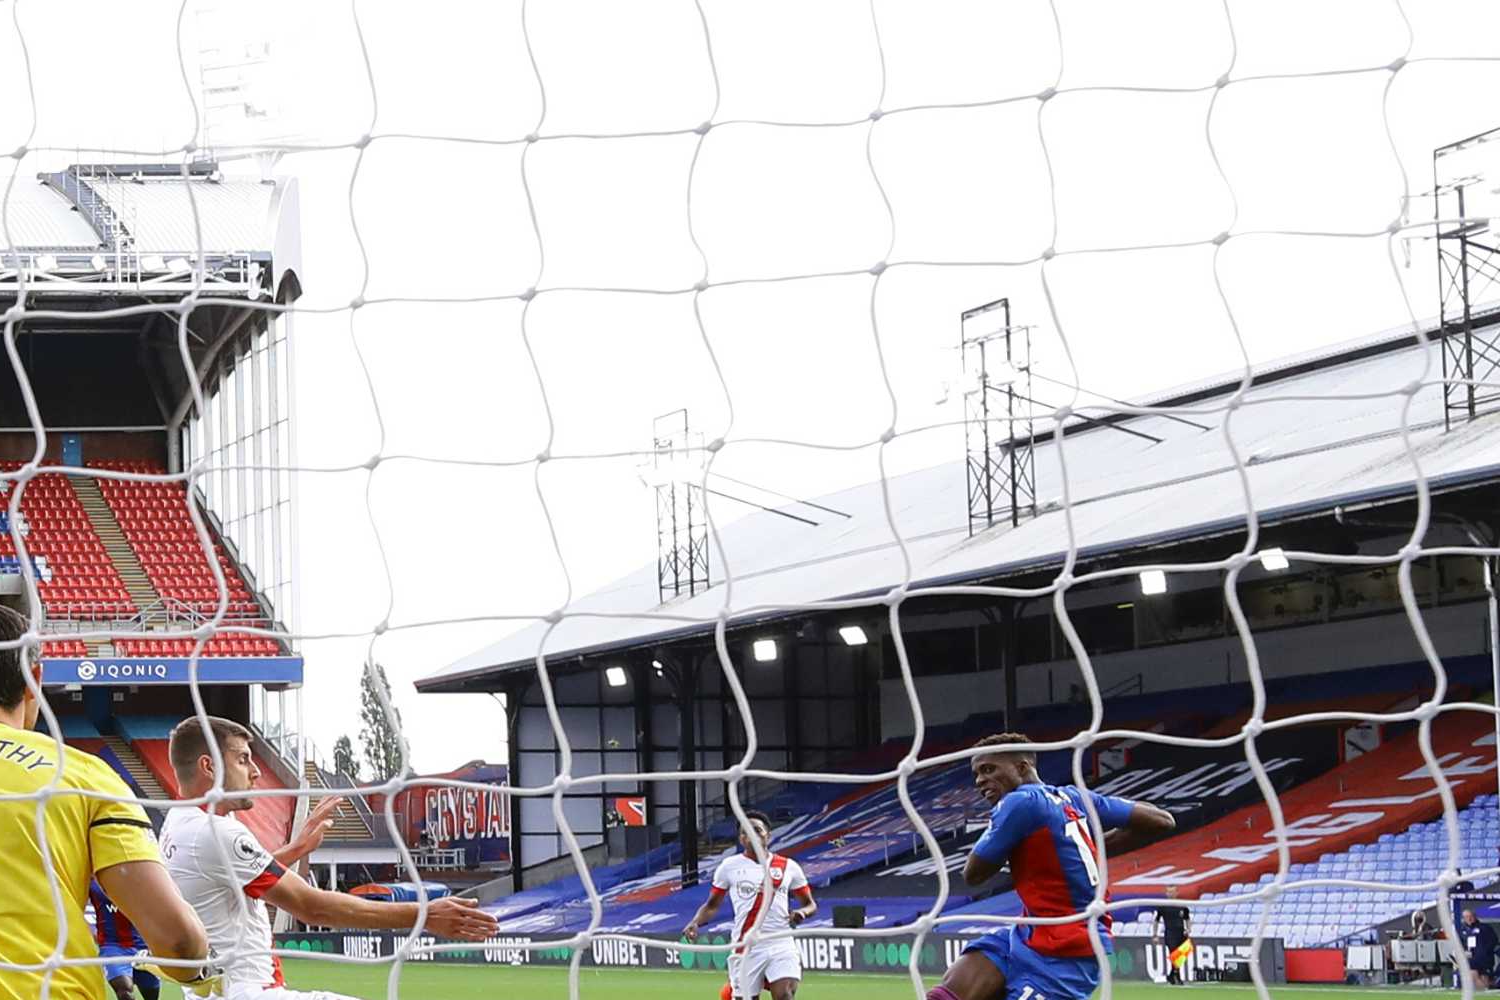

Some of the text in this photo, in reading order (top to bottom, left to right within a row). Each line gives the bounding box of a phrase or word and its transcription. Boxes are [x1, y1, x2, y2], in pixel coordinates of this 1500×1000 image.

[99, 663, 167, 678] IQONIQ
[425, 781, 510, 843] CRYSTAL
[343, 936, 382, 959] UNIBET
[393, 937, 436, 960] UBET
[592, 939, 648, 966] UNIBET
[797, 938, 854, 969] NIBET
